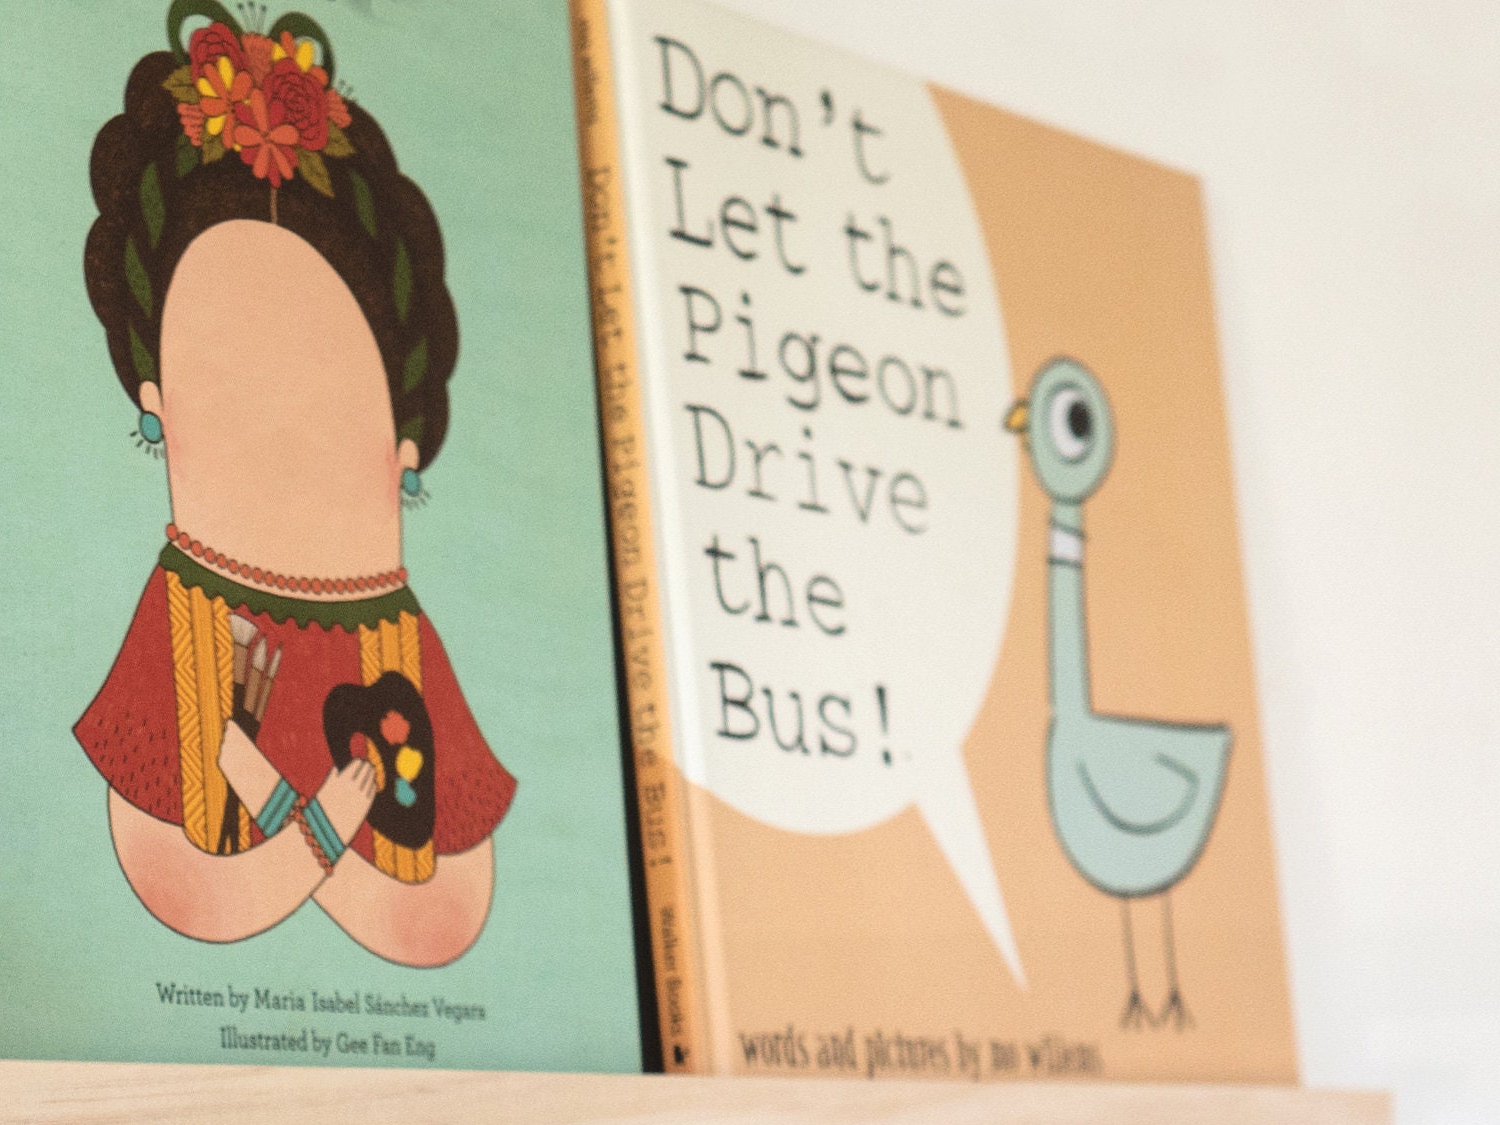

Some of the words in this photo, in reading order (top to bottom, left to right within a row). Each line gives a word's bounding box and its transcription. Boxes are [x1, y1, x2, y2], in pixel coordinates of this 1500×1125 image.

[653, 35, 891, 185] Don't
[664, 156, 806, 274] Let
[843, 211, 967, 317] the
[678, 284, 963, 430] Pigeon
[684, 403, 929, 534] Drive
[702, 534, 847, 637] the
[709, 661, 893, 767] Bus!
[155, 981, 225, 1008] Written
[227, 985, 249, 1013] by
[254, 986, 306, 1012] Maria
[311, 990, 361, 1016] Isabel
[219, 1025, 309, 1054] Illustrated
[311, 1030, 331, 1058] by
[336, 1032, 369, 1056] Gee
